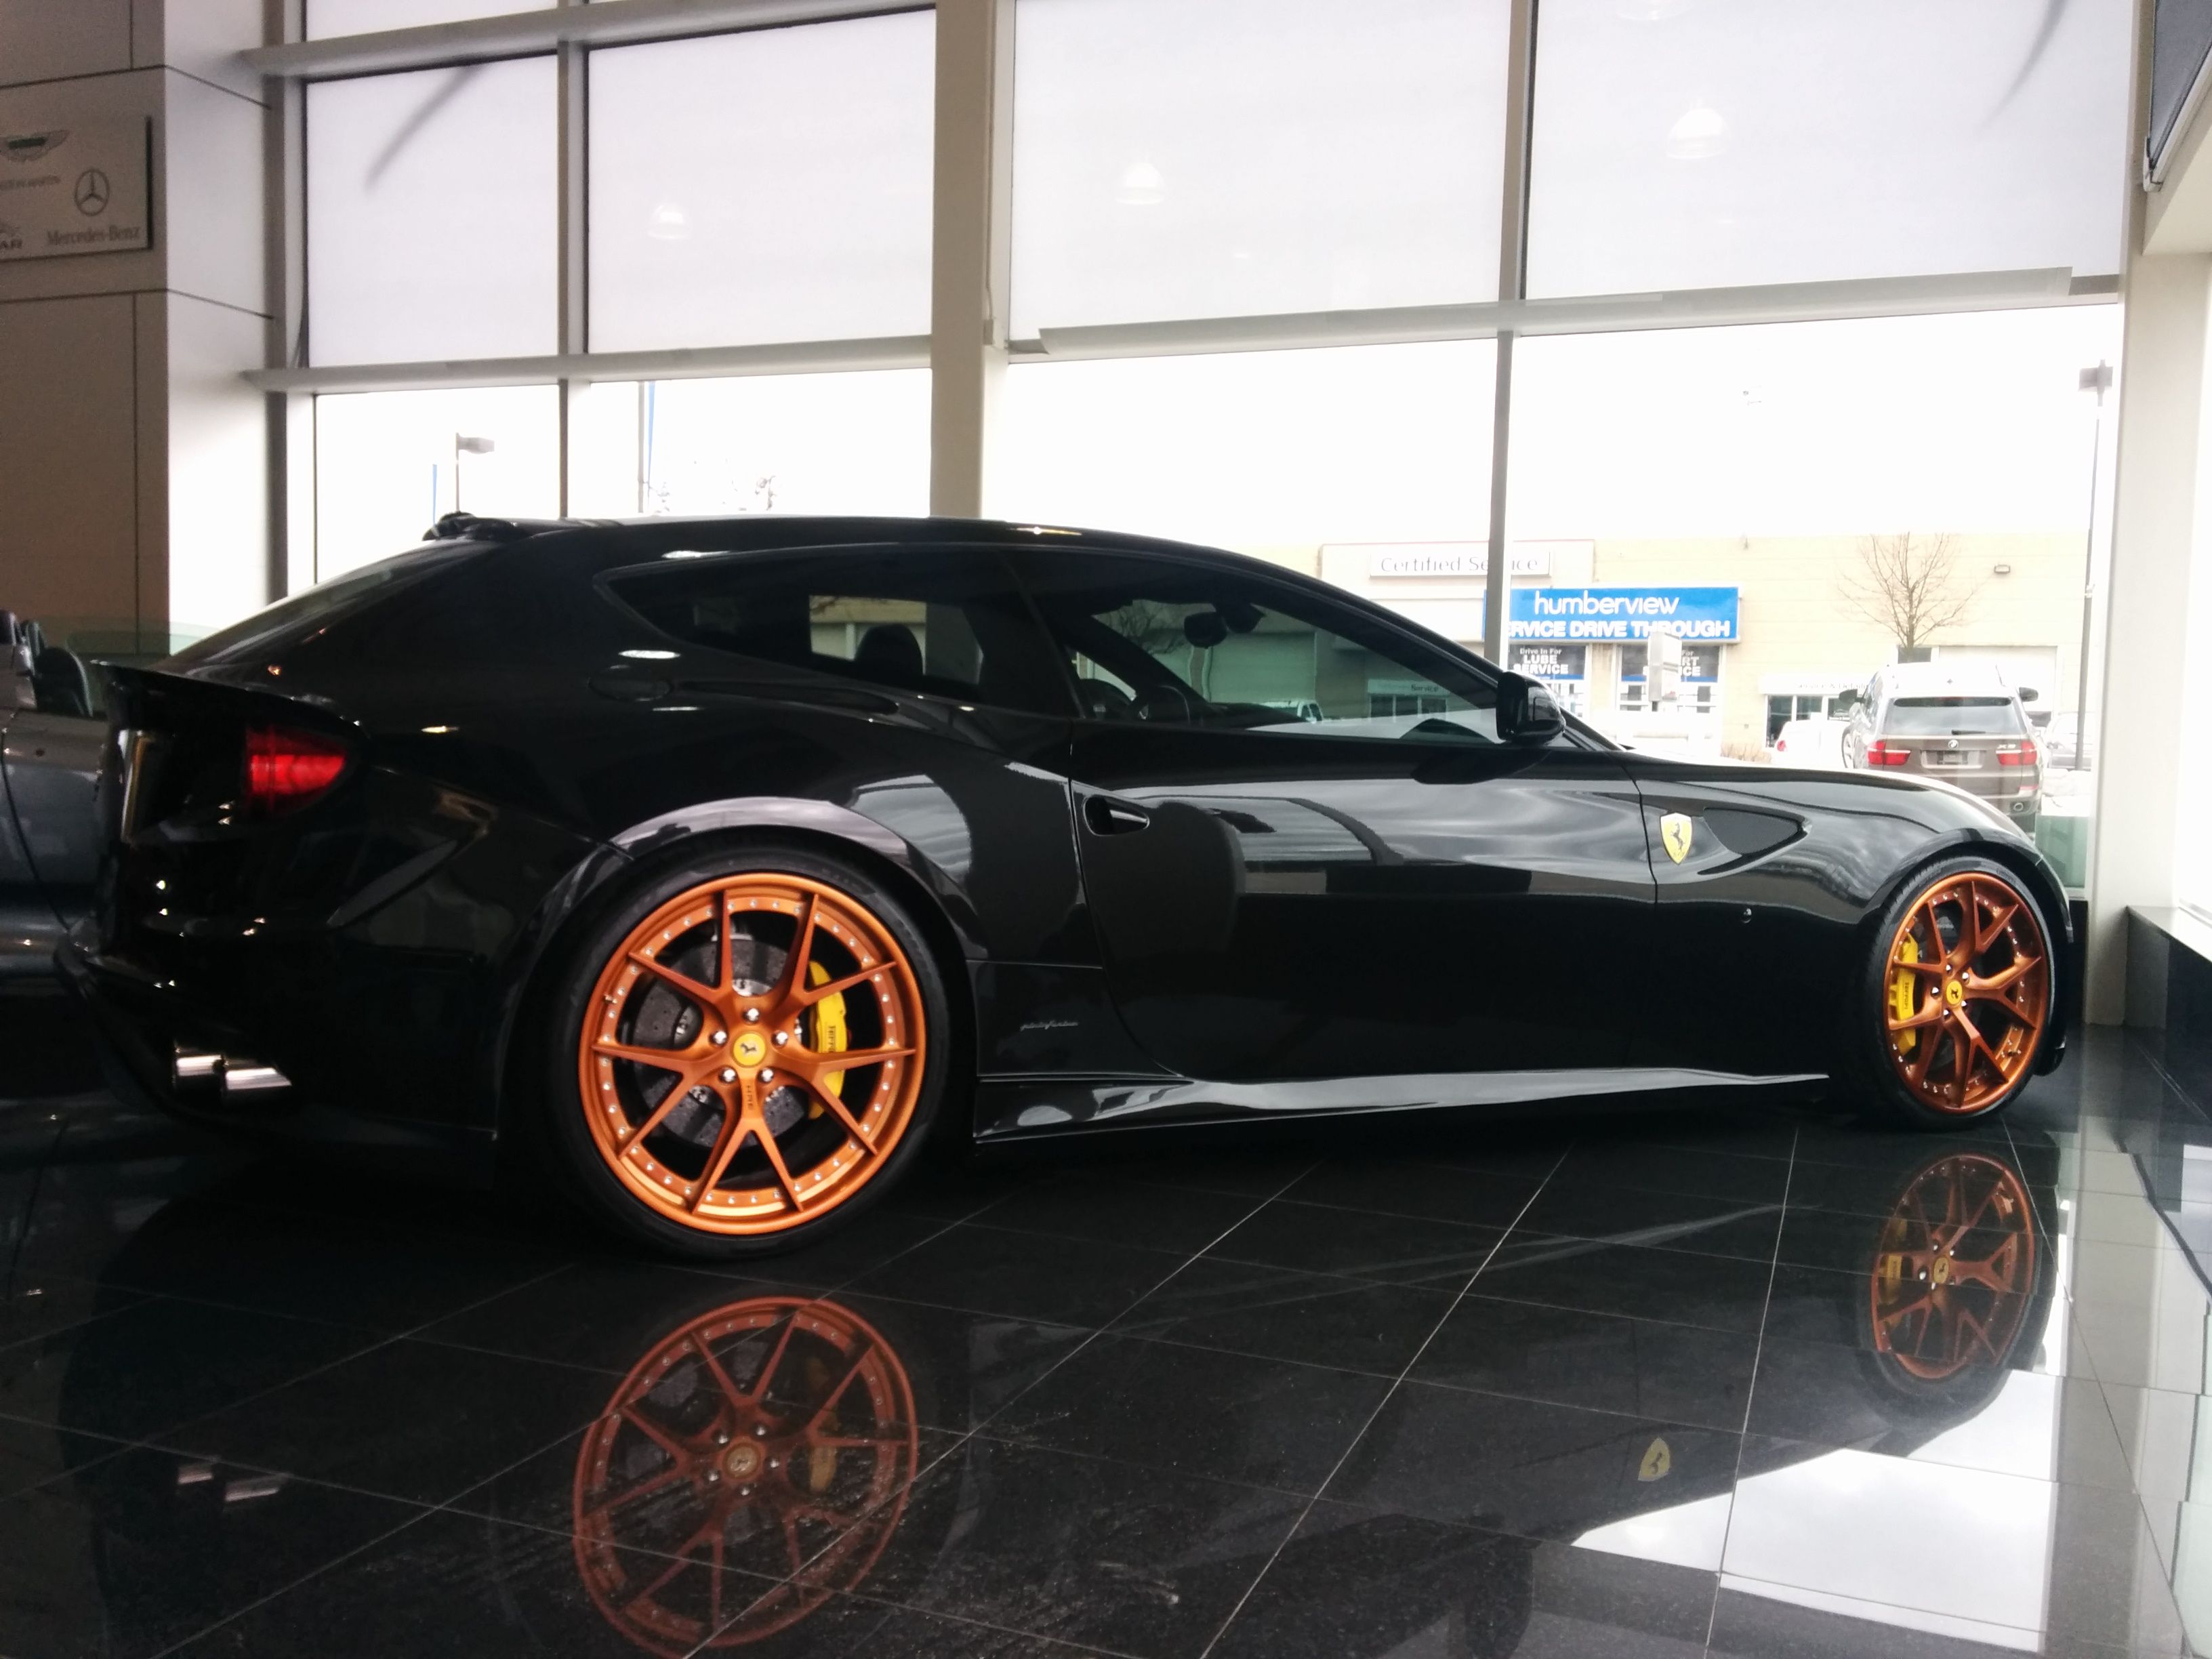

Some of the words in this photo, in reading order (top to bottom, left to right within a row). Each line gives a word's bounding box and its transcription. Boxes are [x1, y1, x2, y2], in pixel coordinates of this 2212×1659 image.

[1381, 556, 1460, 571] Certified
[1469, 556, 1538, 571] Seice
[1534, 590, 1679, 615] humberview
[1570, 620, 1627, 637] DRIVE
[1631, 619, 1730, 637] THROUGH
[1523, 655, 1557, 664] LUBE
[1513, 663, 1569, 674] SERVICE
